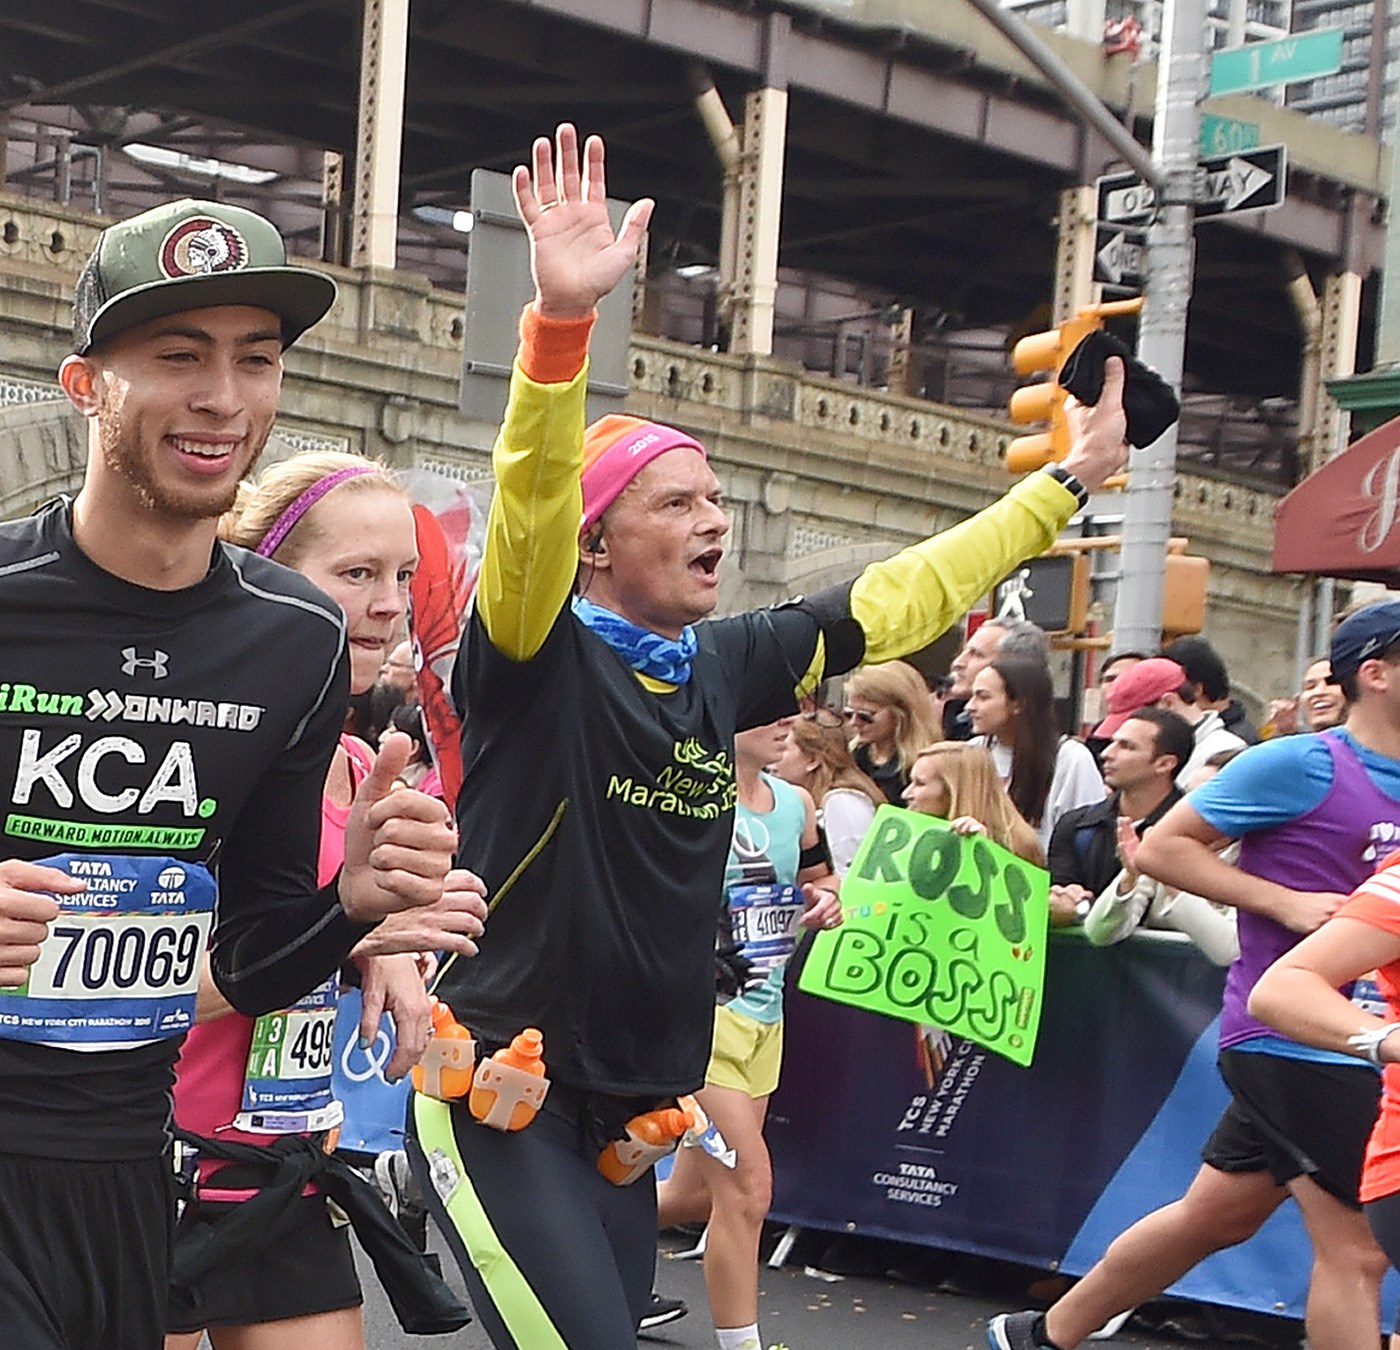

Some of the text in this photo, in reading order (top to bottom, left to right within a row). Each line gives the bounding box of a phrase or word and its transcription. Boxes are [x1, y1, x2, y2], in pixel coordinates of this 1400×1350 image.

[1270, 42, 1298, 63] AV
[122, 695, 261, 731] ONWARD
[11, 729, 218, 818] KCA.
[657, 766, 709, 798] New
[69, 861, 112, 876] TATA
[857, 816, 1033, 944] ROSS
[150, 892, 185, 905] TATA
[757, 909, 796, 936] 41097
[886, 902, 980, 961] is a
[52, 924, 200, 989] 70069
[825, 928, 1036, 1049] BOSS!
[269, 1017, 283, 1043] 3
[261, 1048, 277, 1077] A
[919, 1100, 943, 1134] NEW
[936, 1057, 966, 1098] YORK
[936, 1054, 986, 1137] MARATHON
[897, 1095, 928, 1131] TCS
[873, 1173, 958, 1196] CONSULTANCY
[899, 1163, 936, 1179] TATA
[887, 1188, 943, 1208] SERVICES
